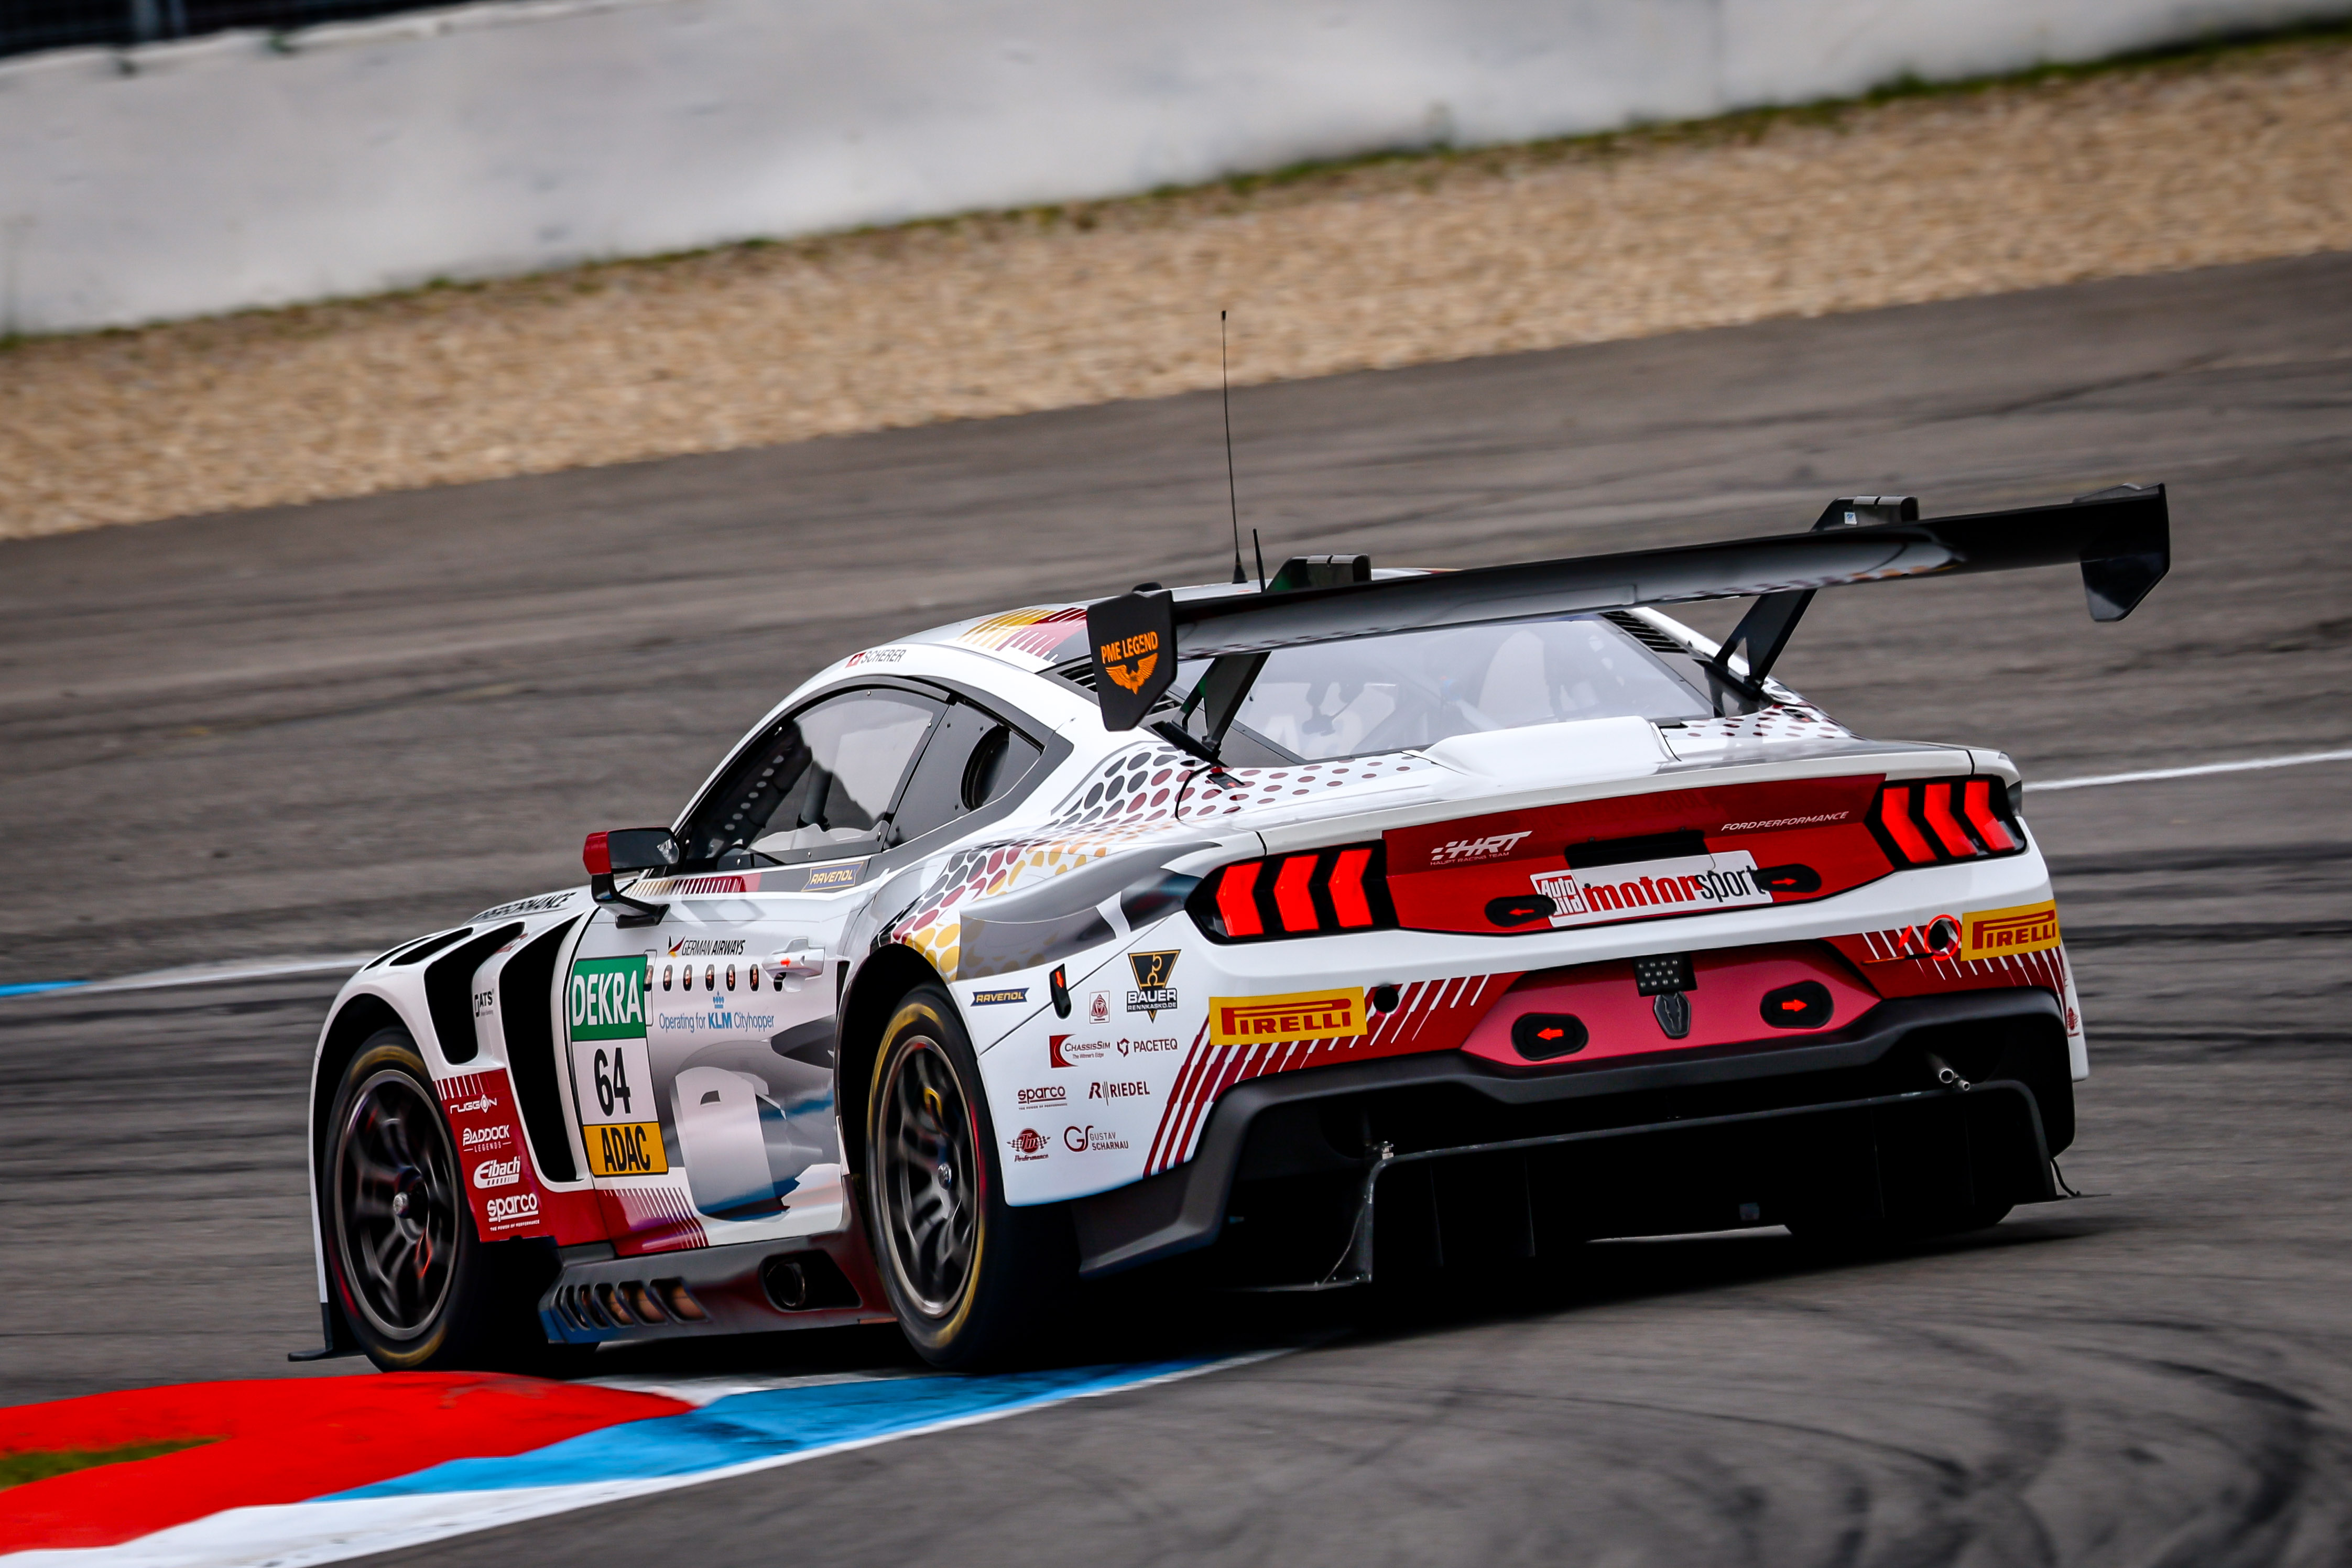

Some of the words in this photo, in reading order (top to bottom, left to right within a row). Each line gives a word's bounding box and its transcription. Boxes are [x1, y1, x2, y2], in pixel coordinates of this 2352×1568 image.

[861, 649, 907, 664] SCHERER
[1101, 641, 1121, 665] PME
[1122, 631, 1158, 658] LEGEND
[1445, 830, 1533, 858] HRT
[810, 869, 853, 885] RAVENOL
[1541, 878, 1576, 898] Auto
[1972, 909, 2056, 950] PIRELLI
[682, 940, 713, 955] GERMAN
[712, 940, 746, 955] AIRWAYS
[572, 970, 643, 1026] DEKRA
[976, 992, 1023, 1003] RAVENOL
[1128, 989, 1177, 1004] BAUER
[1128, 1002, 1177, 1010] RENNKASKO.DE
[659, 1012, 694, 1033] Operating
[695, 1012, 705, 1029] for
[708, 1012, 732, 1029] KLM
[734, 1012, 775, 1032] Cityhopper
[1221, 998, 1351, 1035] PIRELLI
[1134, 1038, 1178, 1052] PACETEQ
[594, 1047, 631, 1117] 64
[1110, 1081, 1150, 1098] RIEDEL
[1018, 1086, 1065, 1104] sparco
[463, 1124, 510, 1146] PADDOCK
[1090, 1132, 1116, 1141] GUSTAV
[474, 1141, 502, 1152] LEGENDS
[601, 1125, 651, 1173] ADAC
[1092, 1140, 1129, 1151] SCHARNAU
[473, 1156, 520, 1189] Eibach
[487, 1193, 538, 1223] sparco
